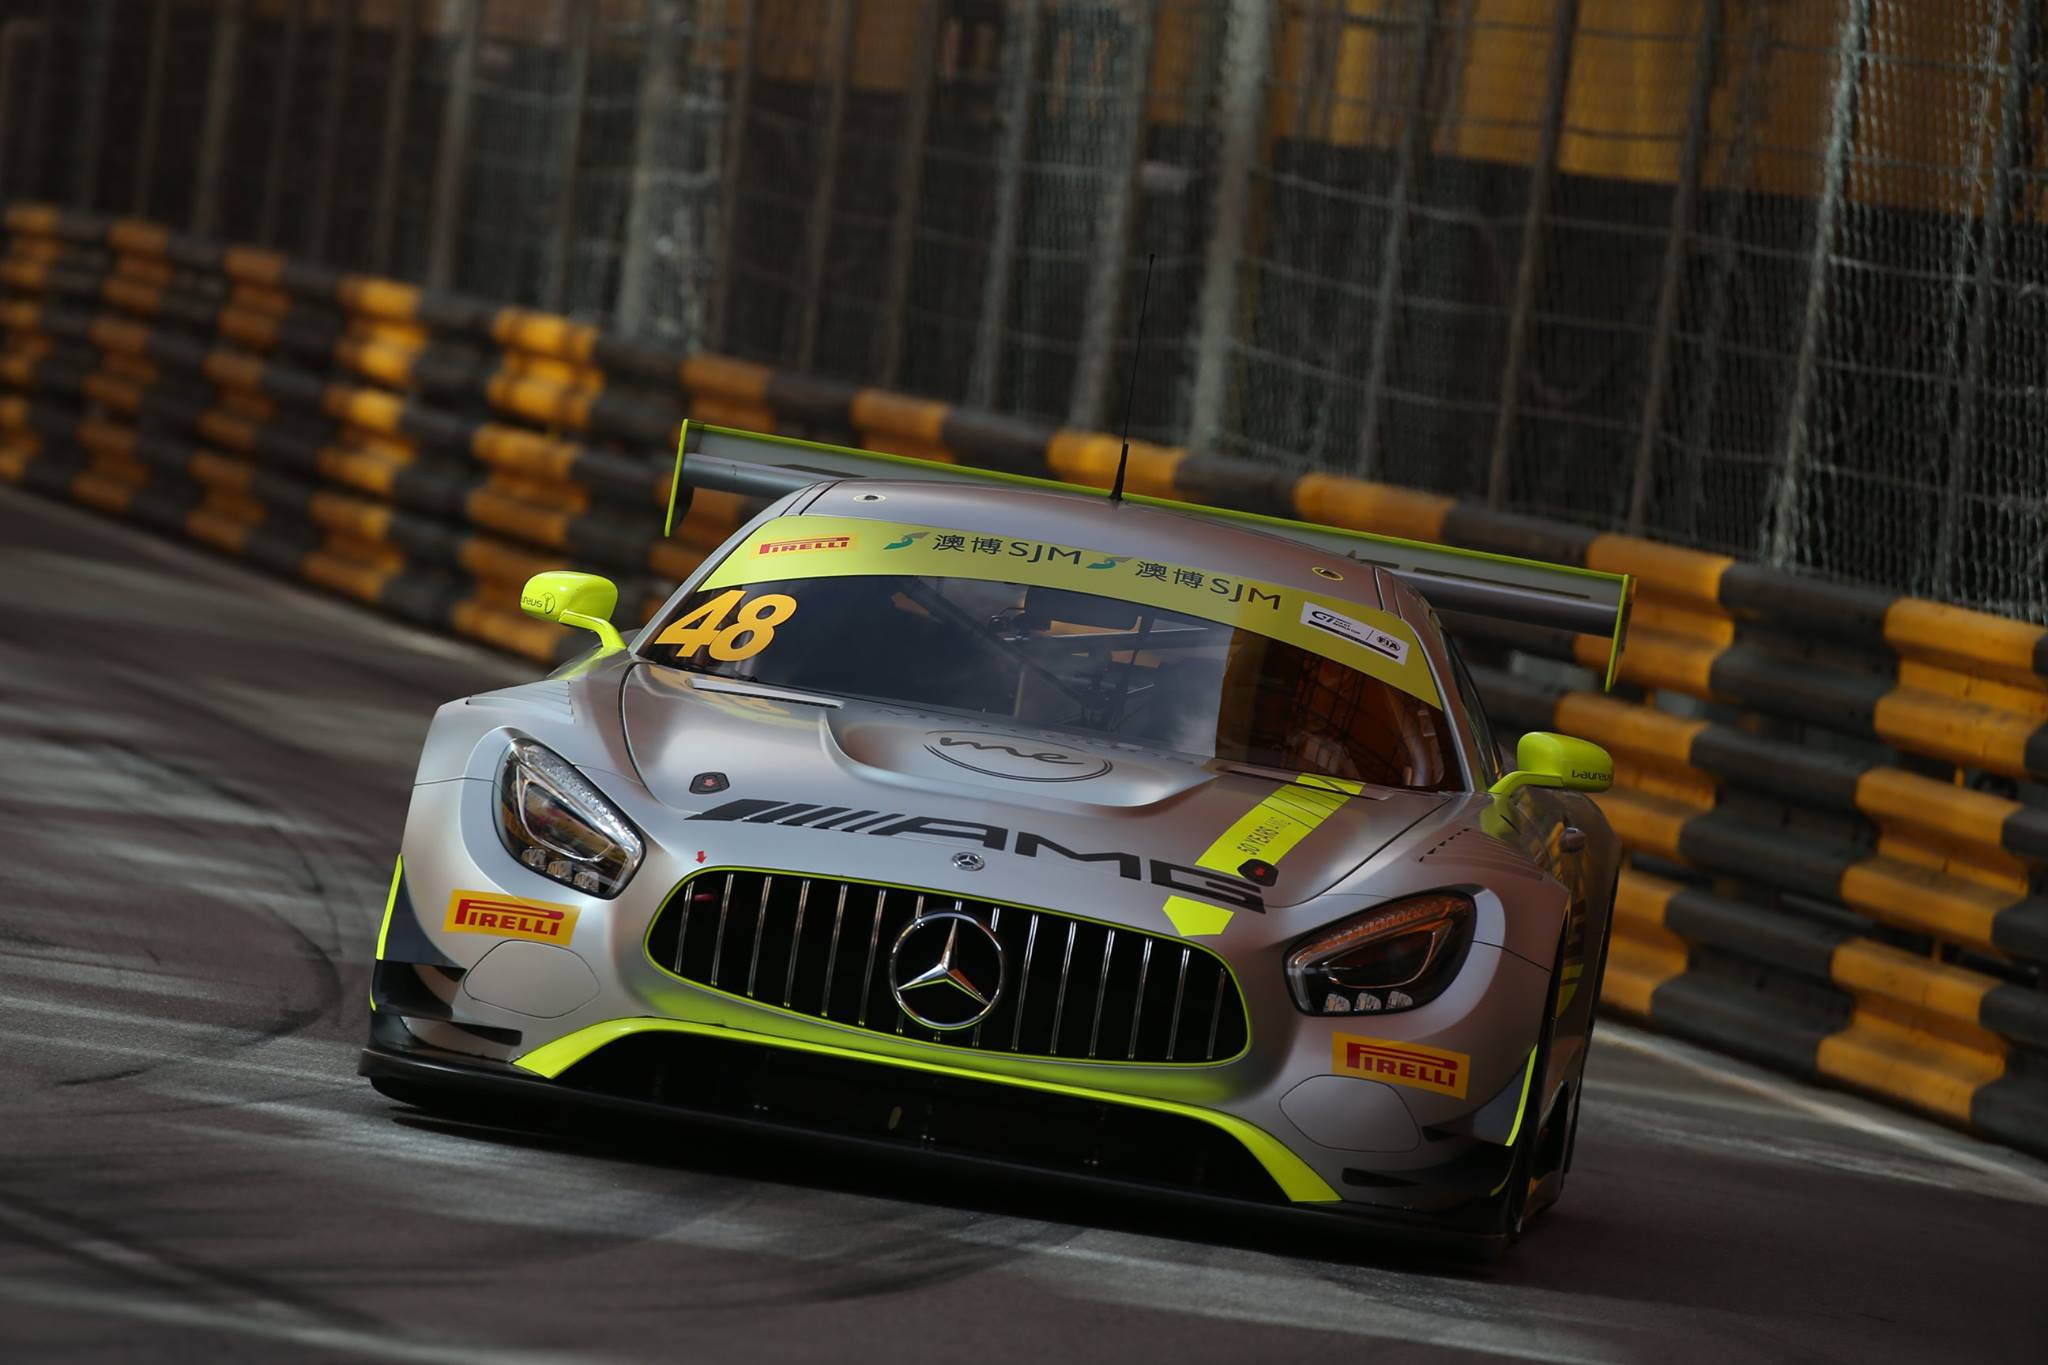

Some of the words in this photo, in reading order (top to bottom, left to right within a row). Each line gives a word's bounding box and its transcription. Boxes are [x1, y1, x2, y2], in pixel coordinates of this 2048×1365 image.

[759, 536, 849, 555] PIRELLI
[654, 589, 797, 662] 48
[1311, 610, 1352, 625] GT
[1377, 635, 1401, 652] FIA
[868, 815, 1265, 914] AMG
[454, 899, 564, 937] PIRELLI
[1346, 1042, 1459, 1088] PIRELLI
